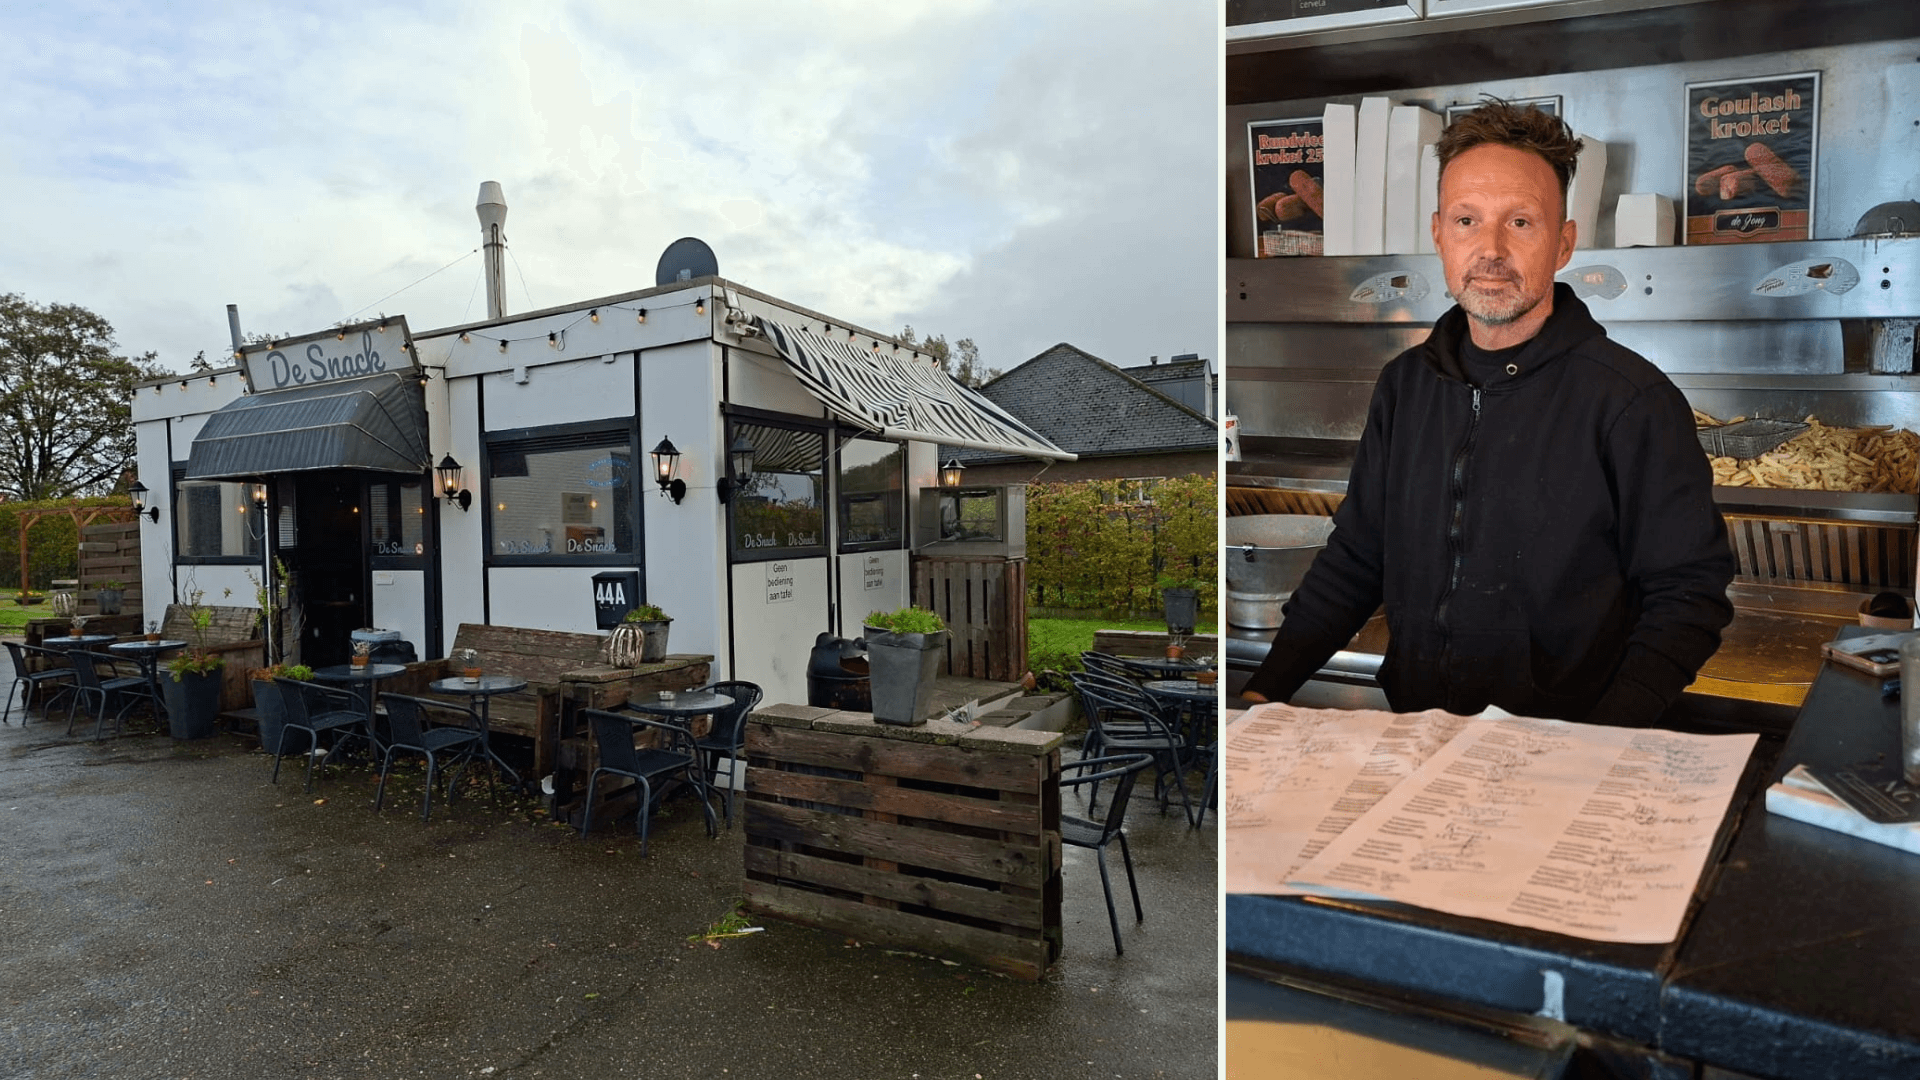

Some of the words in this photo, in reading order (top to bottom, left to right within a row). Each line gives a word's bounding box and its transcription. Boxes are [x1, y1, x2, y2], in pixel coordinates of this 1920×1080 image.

[1700, 88, 1801, 118] Goulash
[1710, 112, 1791, 139] kroket
[1256, 148, 1303, 165] kroket
[266, 350, 307, 388] De
[306, 331, 386, 381] Snack
[567, 538, 583, 552] De
[584, 538, 616, 552] Snack
[745, 533, 756, 549] De
[773, 563, 788, 573] Geen
[596, 582, 626, 605] 44A
